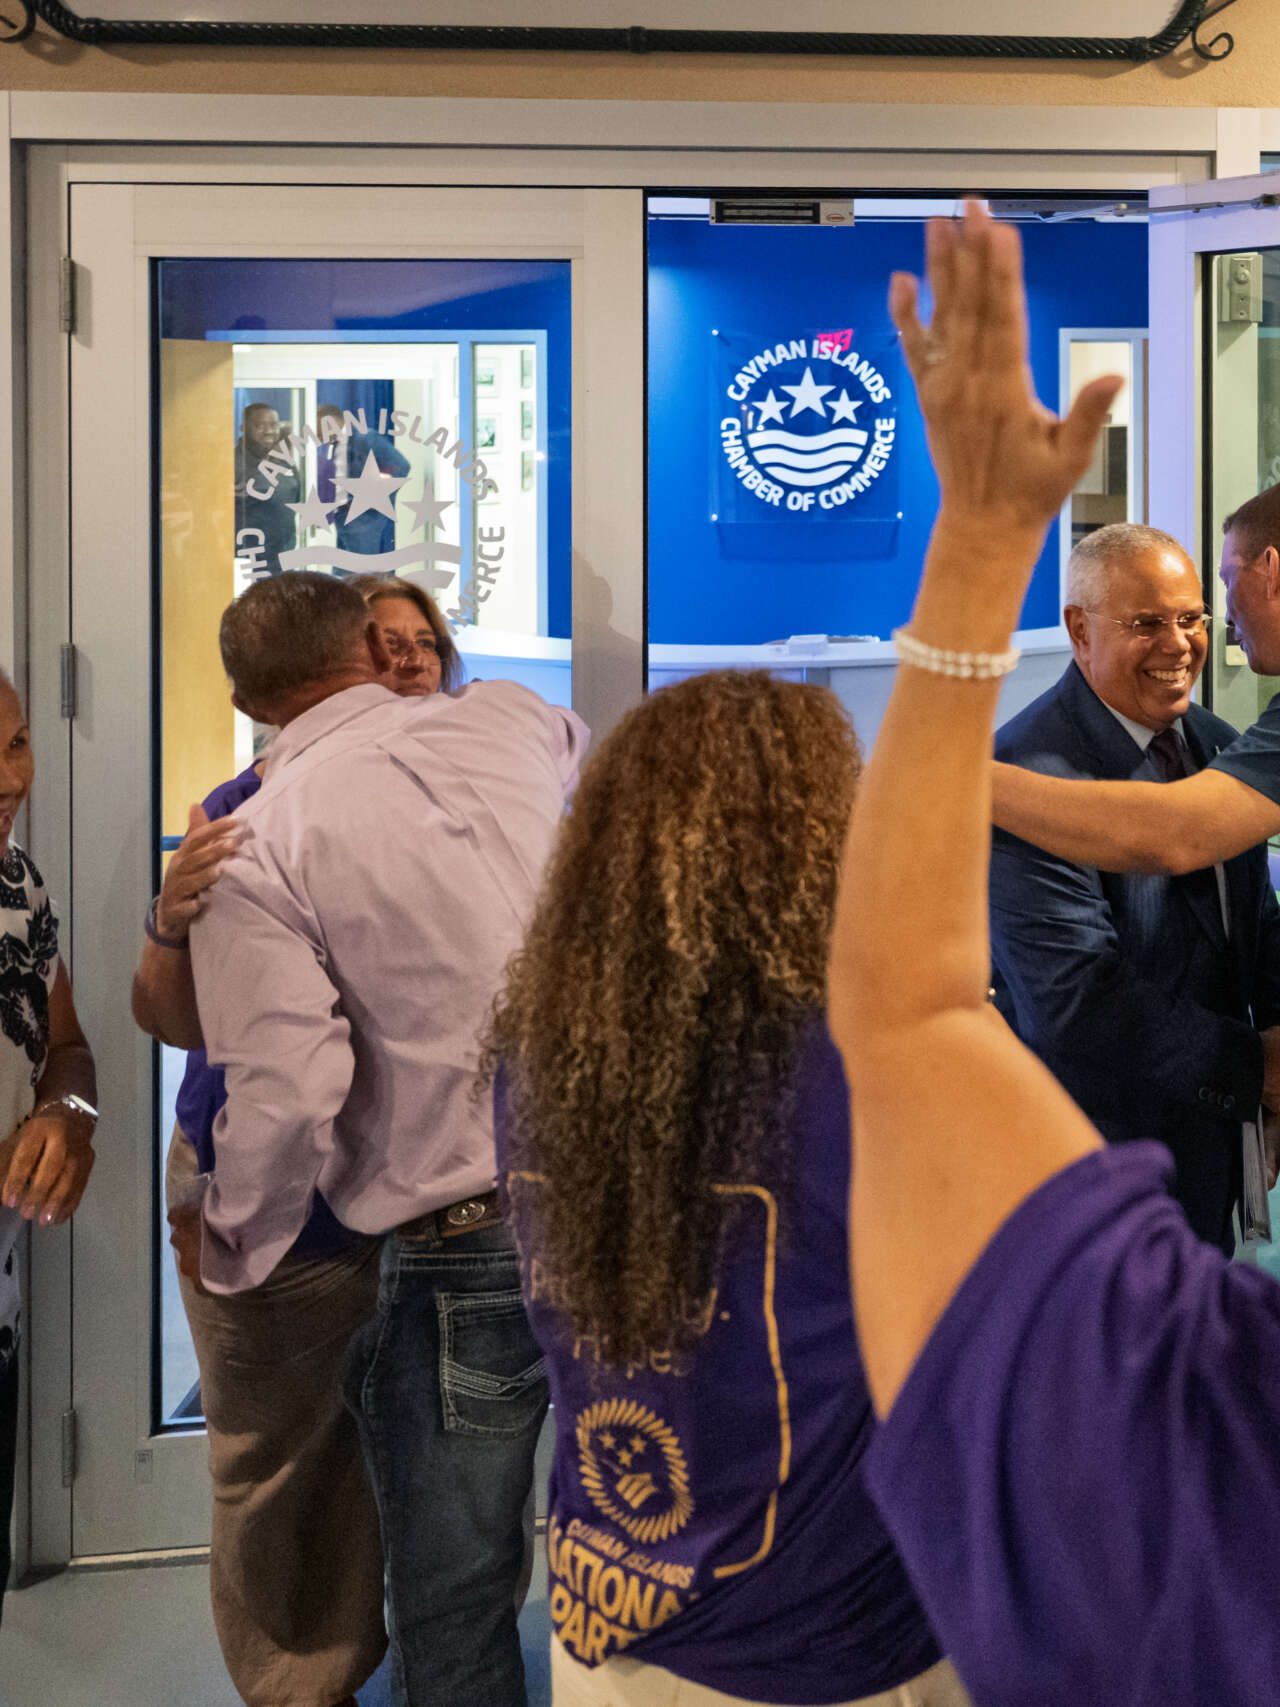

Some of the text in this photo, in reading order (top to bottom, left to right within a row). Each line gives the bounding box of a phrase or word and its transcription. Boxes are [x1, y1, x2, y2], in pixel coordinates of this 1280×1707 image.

[727, 339, 891, 403] CAYMAN ISLANDS
[246, 407, 499, 501] CAYMAN ISLANDS
[720, 417, 896, 511] CHAMBER OF COMMERCE
[443, 526, 505, 636] MERCE
[549, 1516, 682, 1630] ATIONA
[550, 1581, 649, 1663] PART
